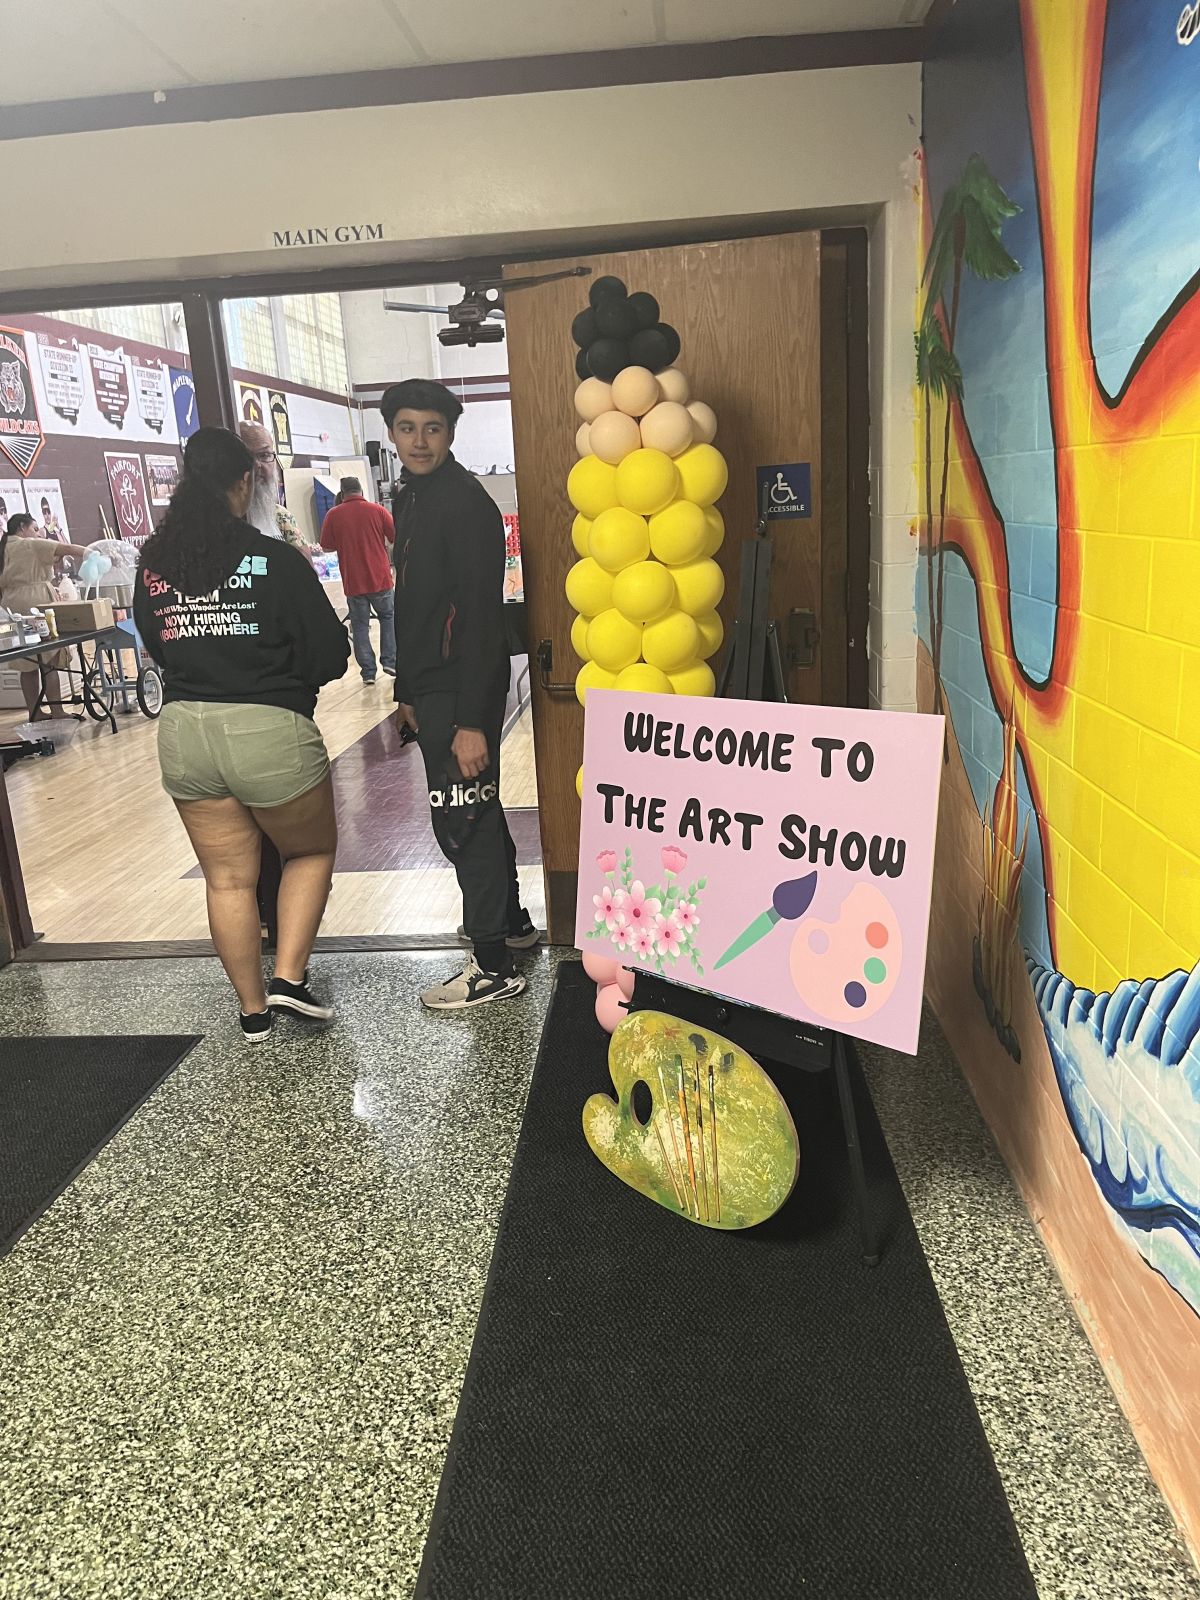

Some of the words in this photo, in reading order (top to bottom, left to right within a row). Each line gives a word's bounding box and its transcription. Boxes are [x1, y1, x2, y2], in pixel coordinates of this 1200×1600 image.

[273, 228, 329, 247] MAIN
[334, 223, 383, 243] GYM
[110, 459, 141, 480] FAIRPORT
[768, 504, 805, 513] CCESSIBLE
[170, 604, 189, 612] Who
[190, 603, 221, 612] Wander
[164, 613, 191, 628] NOW
[194, 612, 242, 625] HIRING
[623, 711, 795, 773] WELCOME
[811, 736, 875, 783] TO
[596, 783, 667, 833] THE
[678, 797, 764, 851] ART
[778, 813, 907, 879] SHOW
